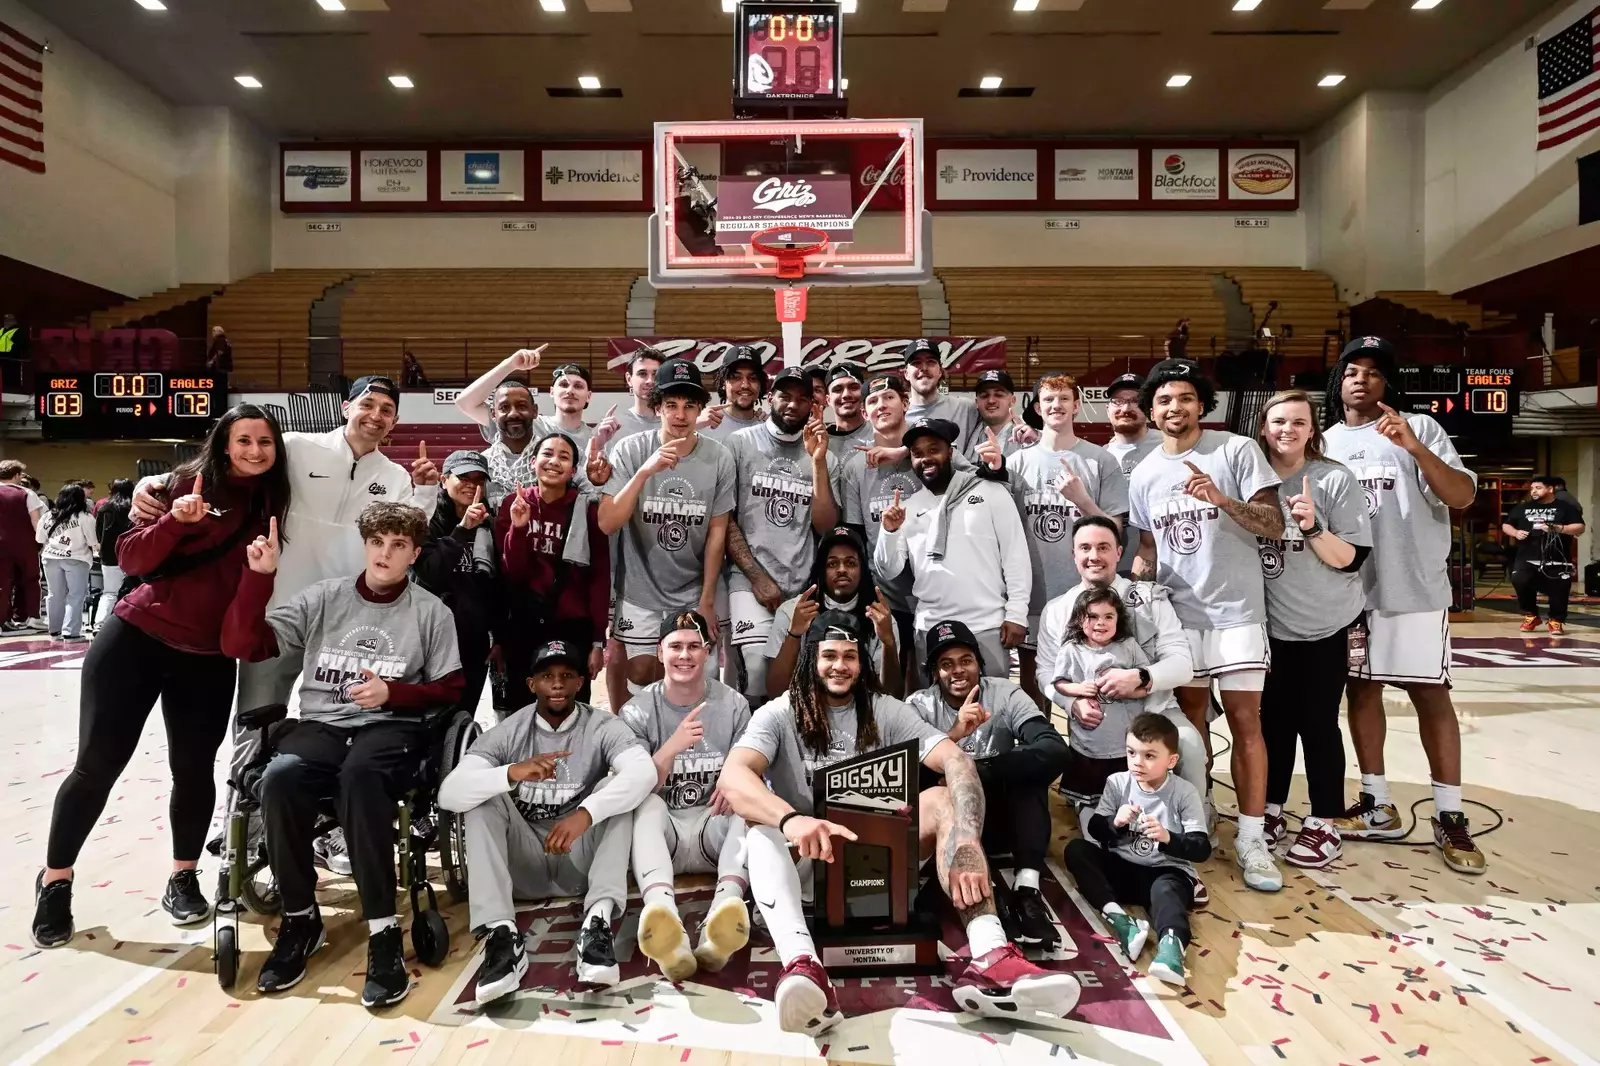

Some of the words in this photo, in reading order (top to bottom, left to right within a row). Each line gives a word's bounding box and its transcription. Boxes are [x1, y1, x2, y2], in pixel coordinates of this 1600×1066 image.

[769, 15, 813, 41] 0.0
[364, 158, 423, 167] HOMEWOOD
[567, 168, 640, 183] Providence
[962, 167, 1035, 183] Providence
[1154, 174, 1217, 187] Blackfoot
[752, 177, 816, 213] Griz
[720, 221, 761, 230] REGULAR
[762, 221, 797, 229] SEASON
[798, 220, 850, 228] CHAMPIONS
[50, 378, 78, 389] GRIZ
[113, 375, 144, 396] 0.0
[169, 378, 214, 389] EAGLES
[1467, 375, 1511, 385] EAGLES
[54, 394, 80, 415] 83
[184, 394, 208, 415] 72
[1430, 400, 1439, 412] 2
[1487, 391, 1506, 412] 10
[134, 404, 142, 417] 2
[368, 482, 387, 496] Griz
[339, 624, 370, 647] UNIVERSITY
[379, 630, 395, 653] MONTANA
[850, 879, 885, 887] CHAMPIONS
[844, 947, 886, 956] UNIVERSITY
[886, 946, 895, 955] OF
[852, 955, 887, 964] MONTANA
